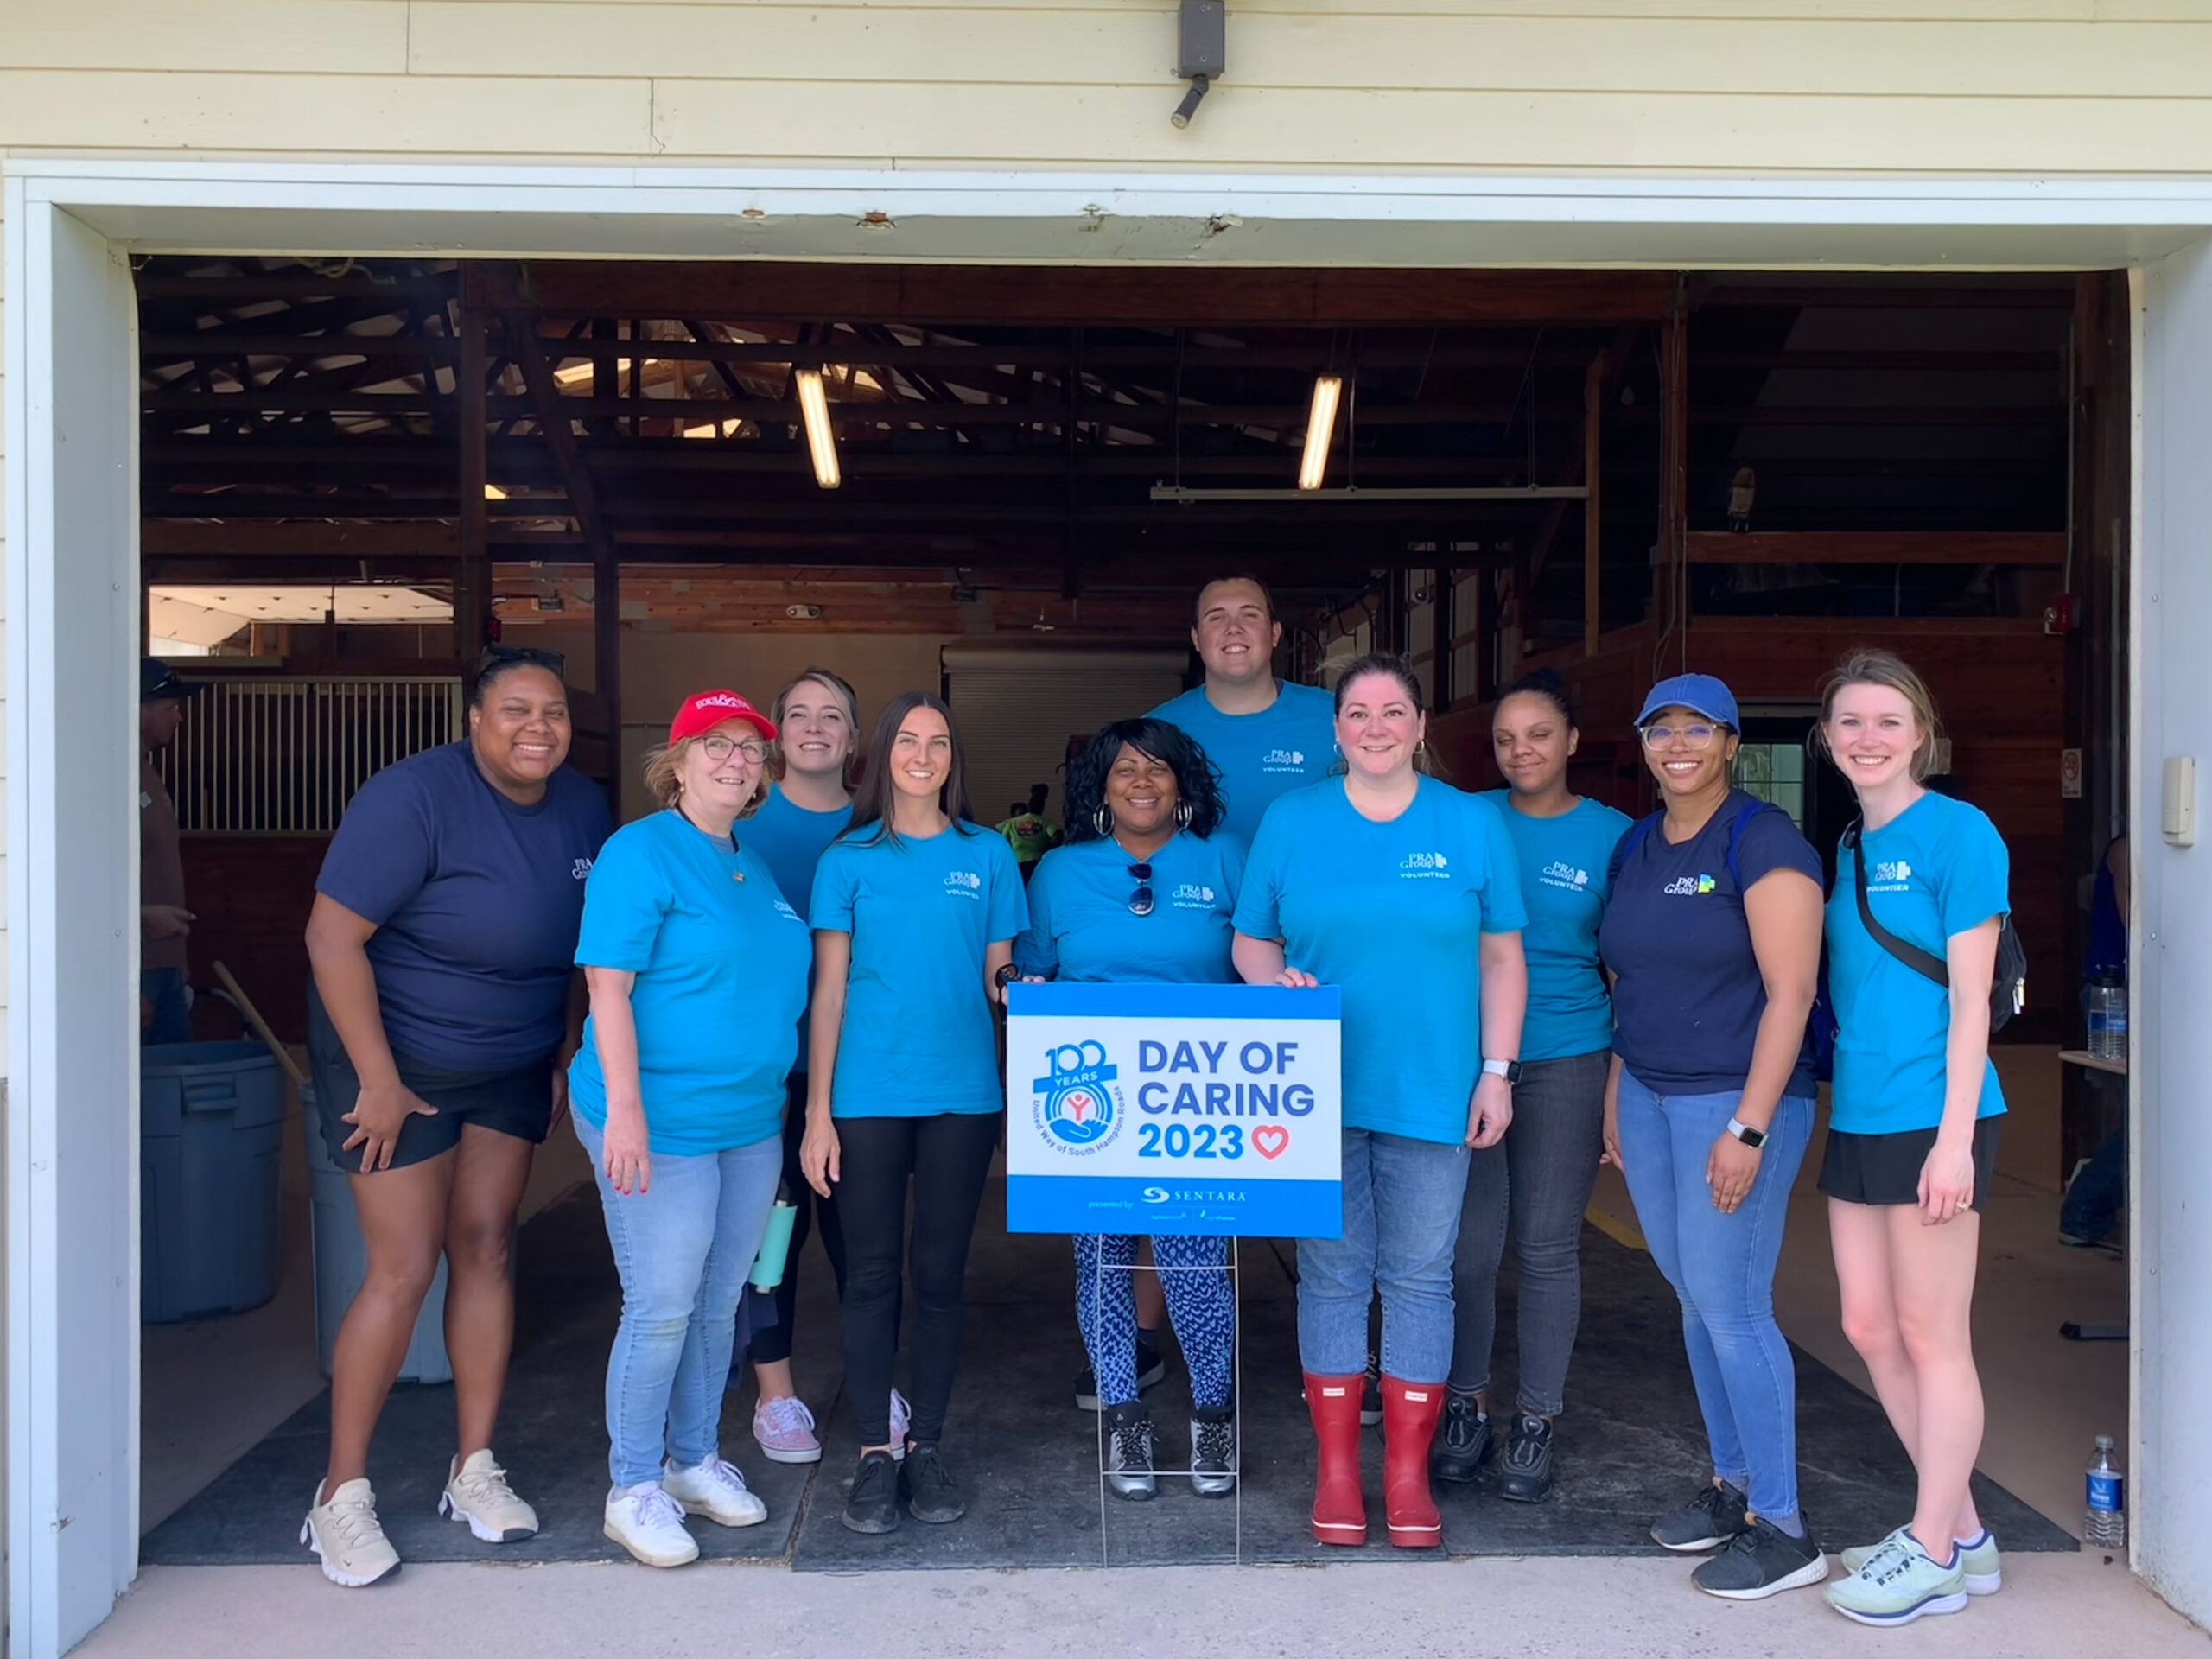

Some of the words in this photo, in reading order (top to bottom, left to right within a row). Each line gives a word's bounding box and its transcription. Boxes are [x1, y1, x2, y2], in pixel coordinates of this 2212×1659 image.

[1400, 860, 1434, 869] Group
[1408, 852, 1433, 862] PRA
[1553, 861, 1574, 876] PRA
[1045, 1039, 1106, 1077] 100
[1139, 1040, 1228, 1074] DAY
[1239, 1041, 1299, 1075] OF
[1054, 1071, 1098, 1087] YEARS
[1137, 1081, 1315, 1117] CARING
[1033, 1100, 1044, 1130] United
[1040, 1130, 1056, 1147] Way
[1056, 1145, 1067, 1154] of
[1068, 1147, 1096, 1156] South
[1096, 1116, 1124, 1151] Hampton
[1114, 1085, 1125, 1115] Roads
[1138, 1123, 1244, 1160] 2023
[1174, 1190, 1245, 1202] SENTARA
